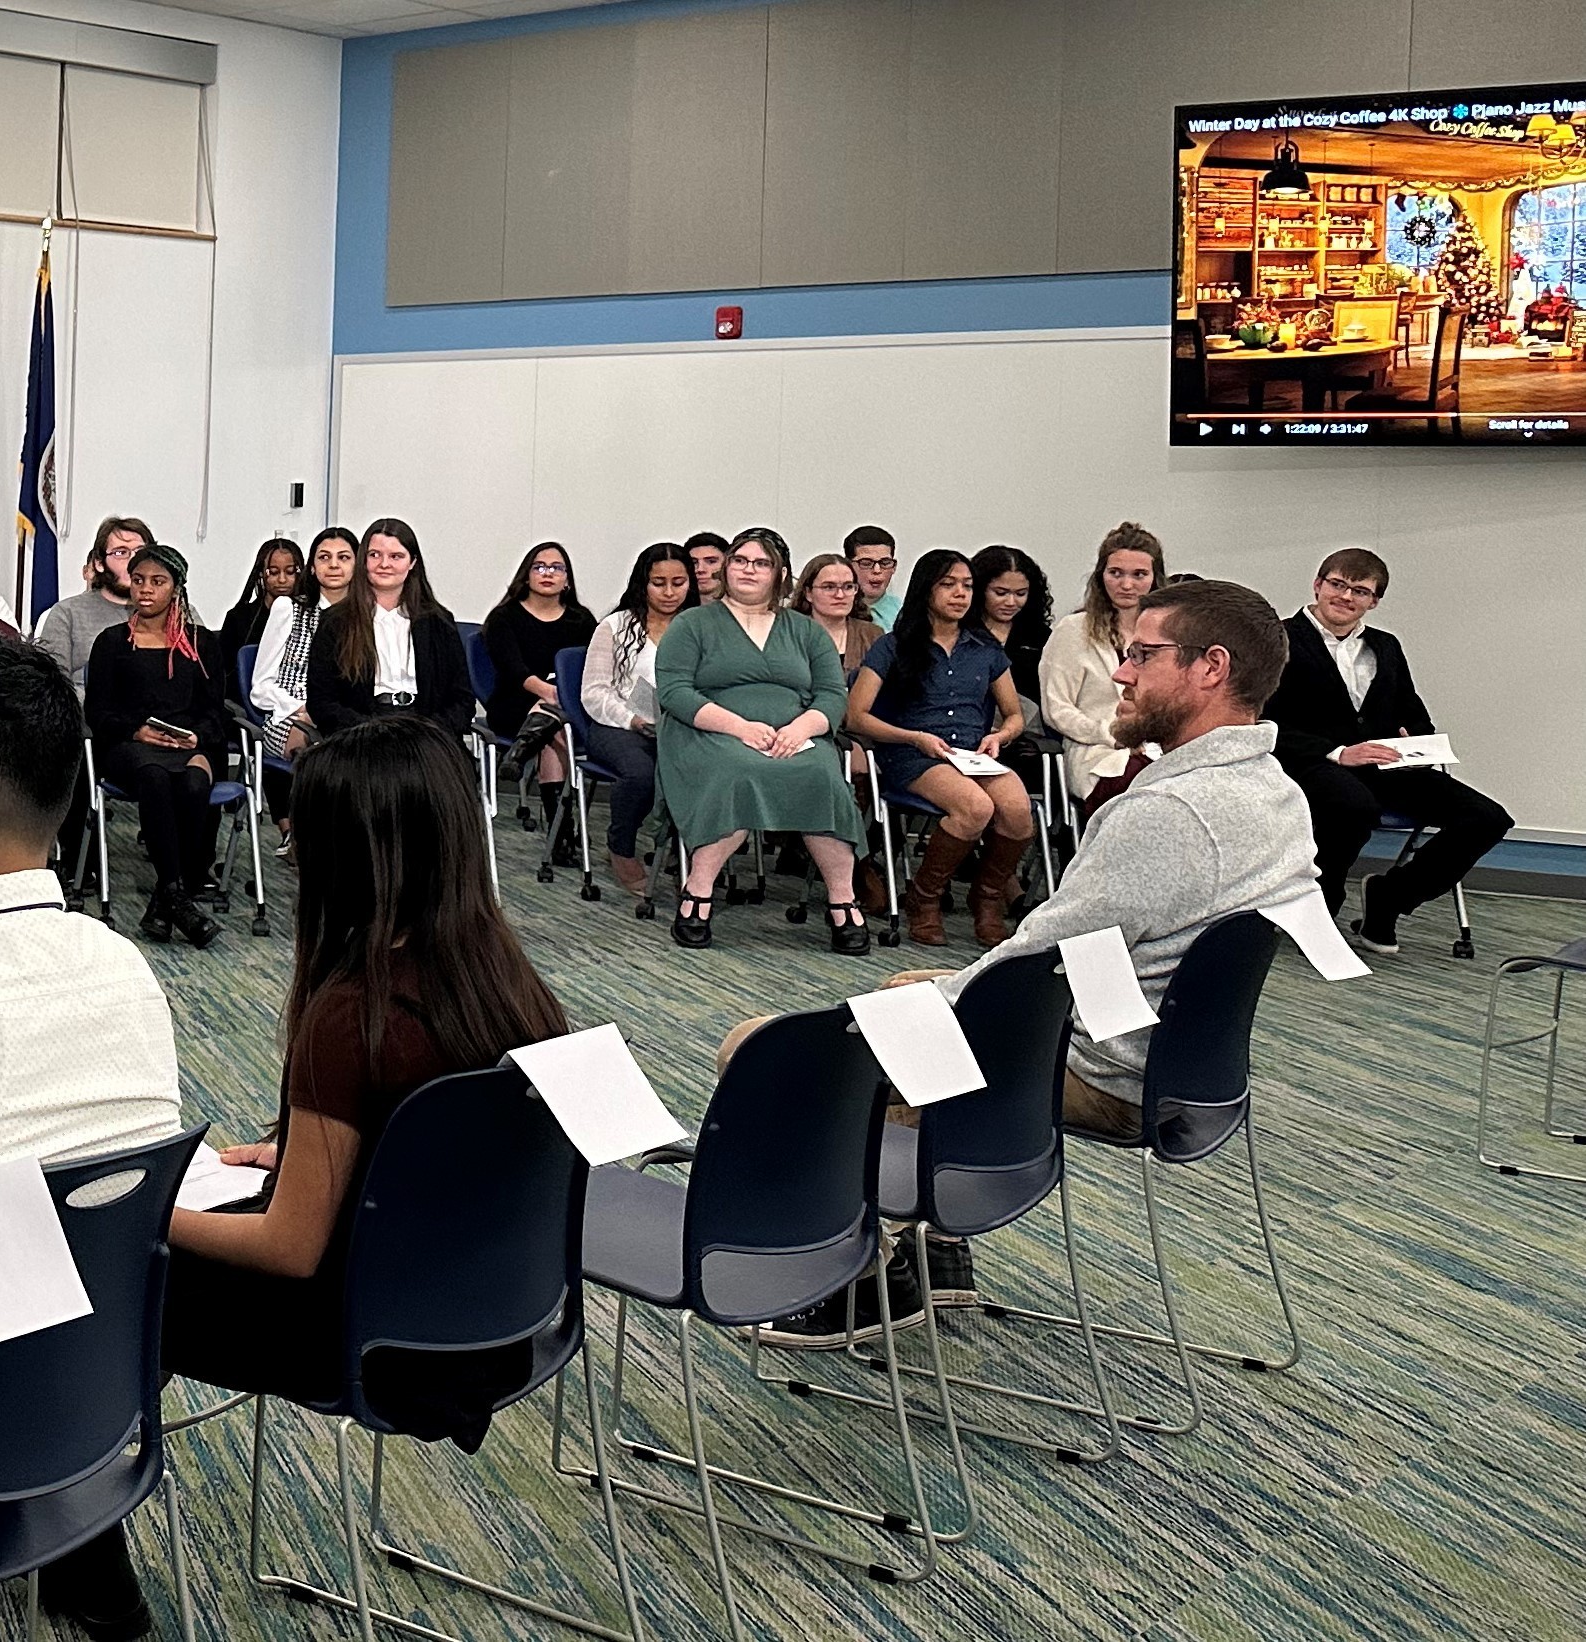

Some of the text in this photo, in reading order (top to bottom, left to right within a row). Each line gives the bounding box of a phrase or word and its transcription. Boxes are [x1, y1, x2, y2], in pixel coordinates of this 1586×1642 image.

[1188, 119, 1232, 133] Winter
[1233, 117, 1260, 132] Day
[1262, 116, 1277, 129] at
[1278, 114, 1302, 128] the
[1303, 111, 1339, 128] Cozy
[1339, 109, 1387, 125] Coffee
[1387, 108, 1409, 122] 4K
[1410, 105, 1449, 122] Shop
[1471, 103, 1514, 118] Piano
[1515, 101, 1551, 115] Jazz
[1488, 419, 1569, 430] Scroll for details
